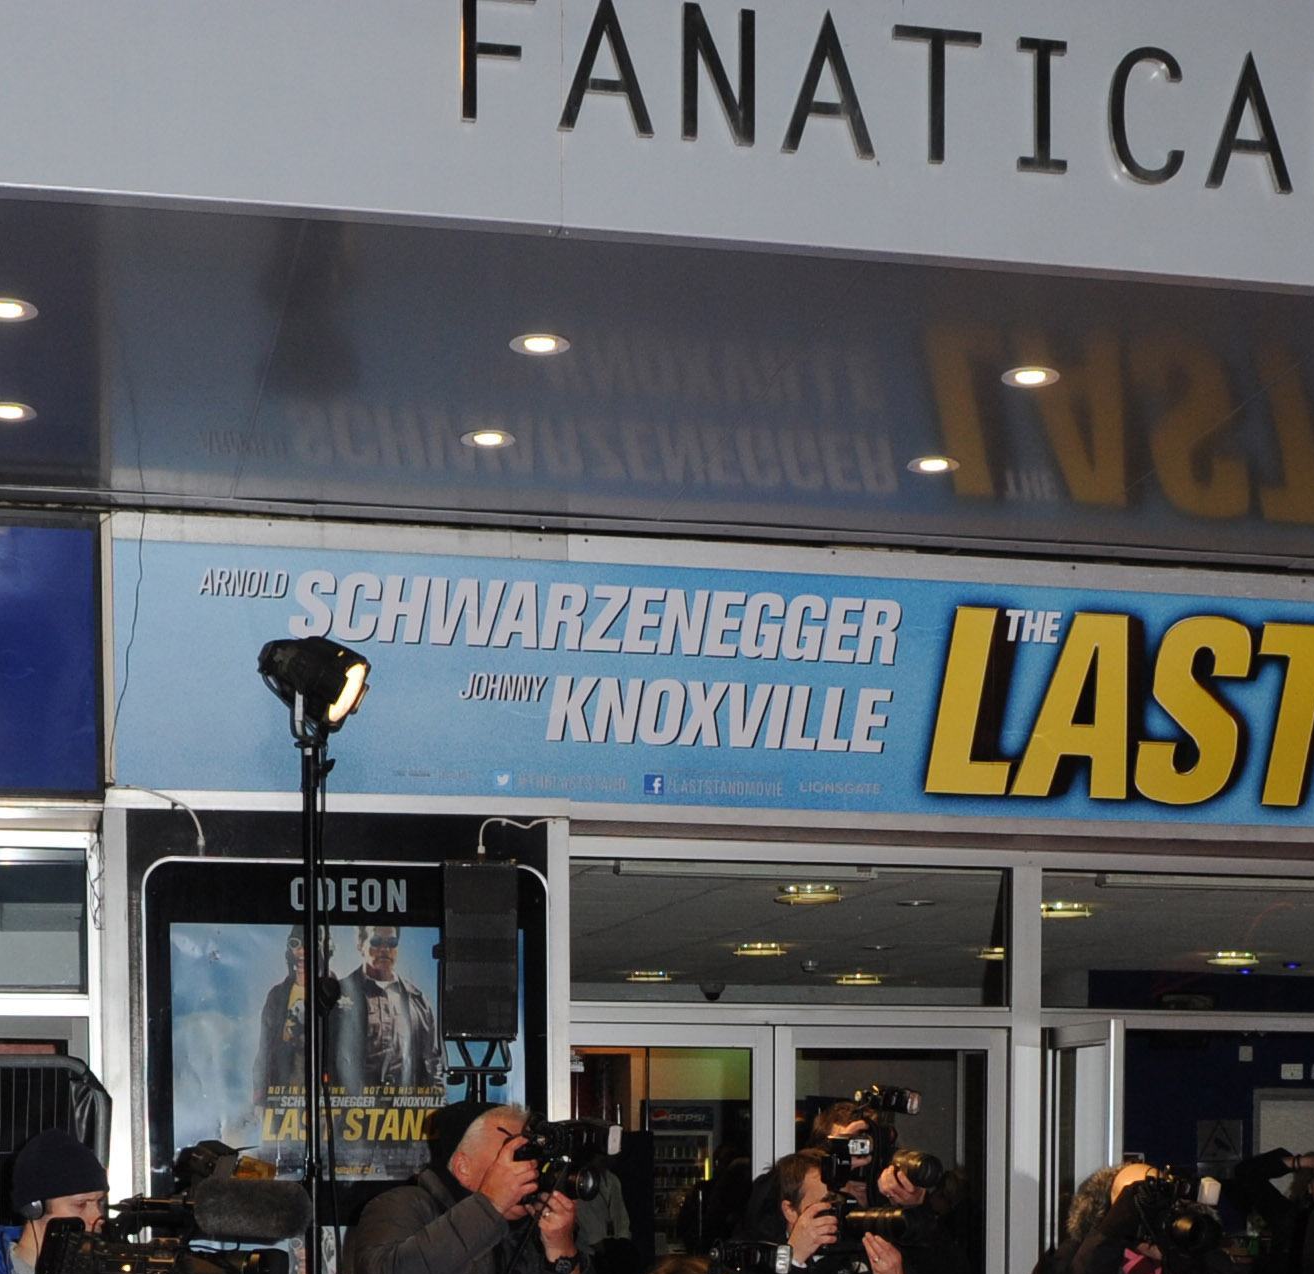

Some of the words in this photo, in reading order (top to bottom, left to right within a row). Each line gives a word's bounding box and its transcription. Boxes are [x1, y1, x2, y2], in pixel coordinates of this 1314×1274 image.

[199, 567, 289, 599] ARNOLD
[288, 569, 902, 665] SCHWARZENEGGER
[1005, 608, 1062, 645] THE
[459, 671, 549, 704] JOHNNY
[544, 676, 893, 754] KNOXVILLE
[290, 876, 408, 914] ODEON
[392, 1096, 447, 1108] KNOXVILLE
[342, 1108, 438, 1142] STAN
